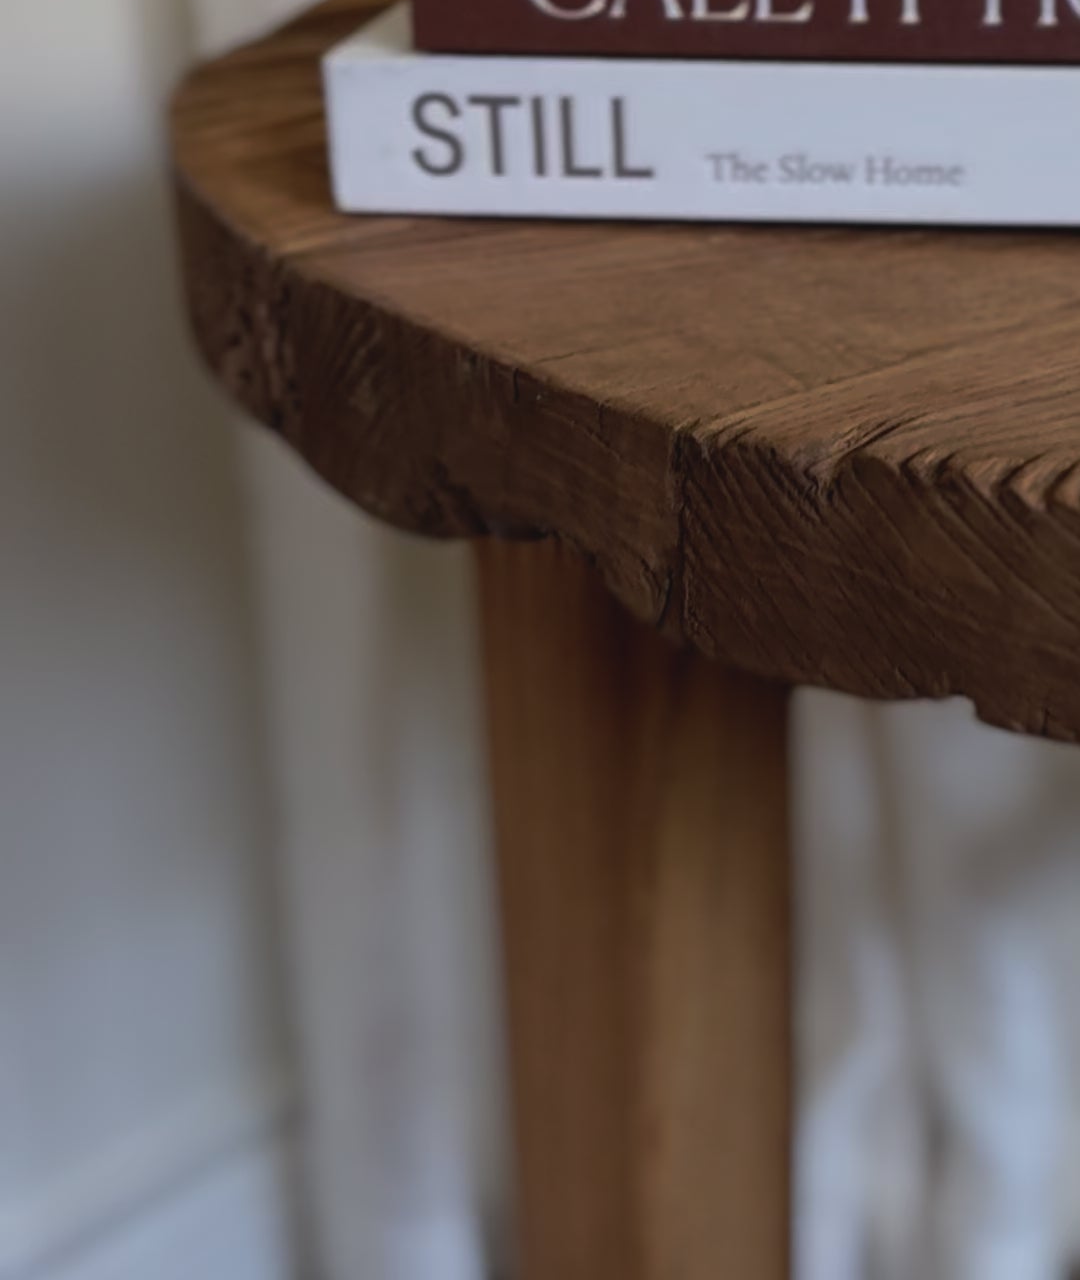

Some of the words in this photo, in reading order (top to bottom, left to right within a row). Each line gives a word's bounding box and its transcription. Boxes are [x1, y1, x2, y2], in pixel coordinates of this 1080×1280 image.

[410, 91, 656, 180] STILL
[706, 152, 766, 184] The
[777, 154, 854, 186] Slow
[864, 156, 966, 188] Home
